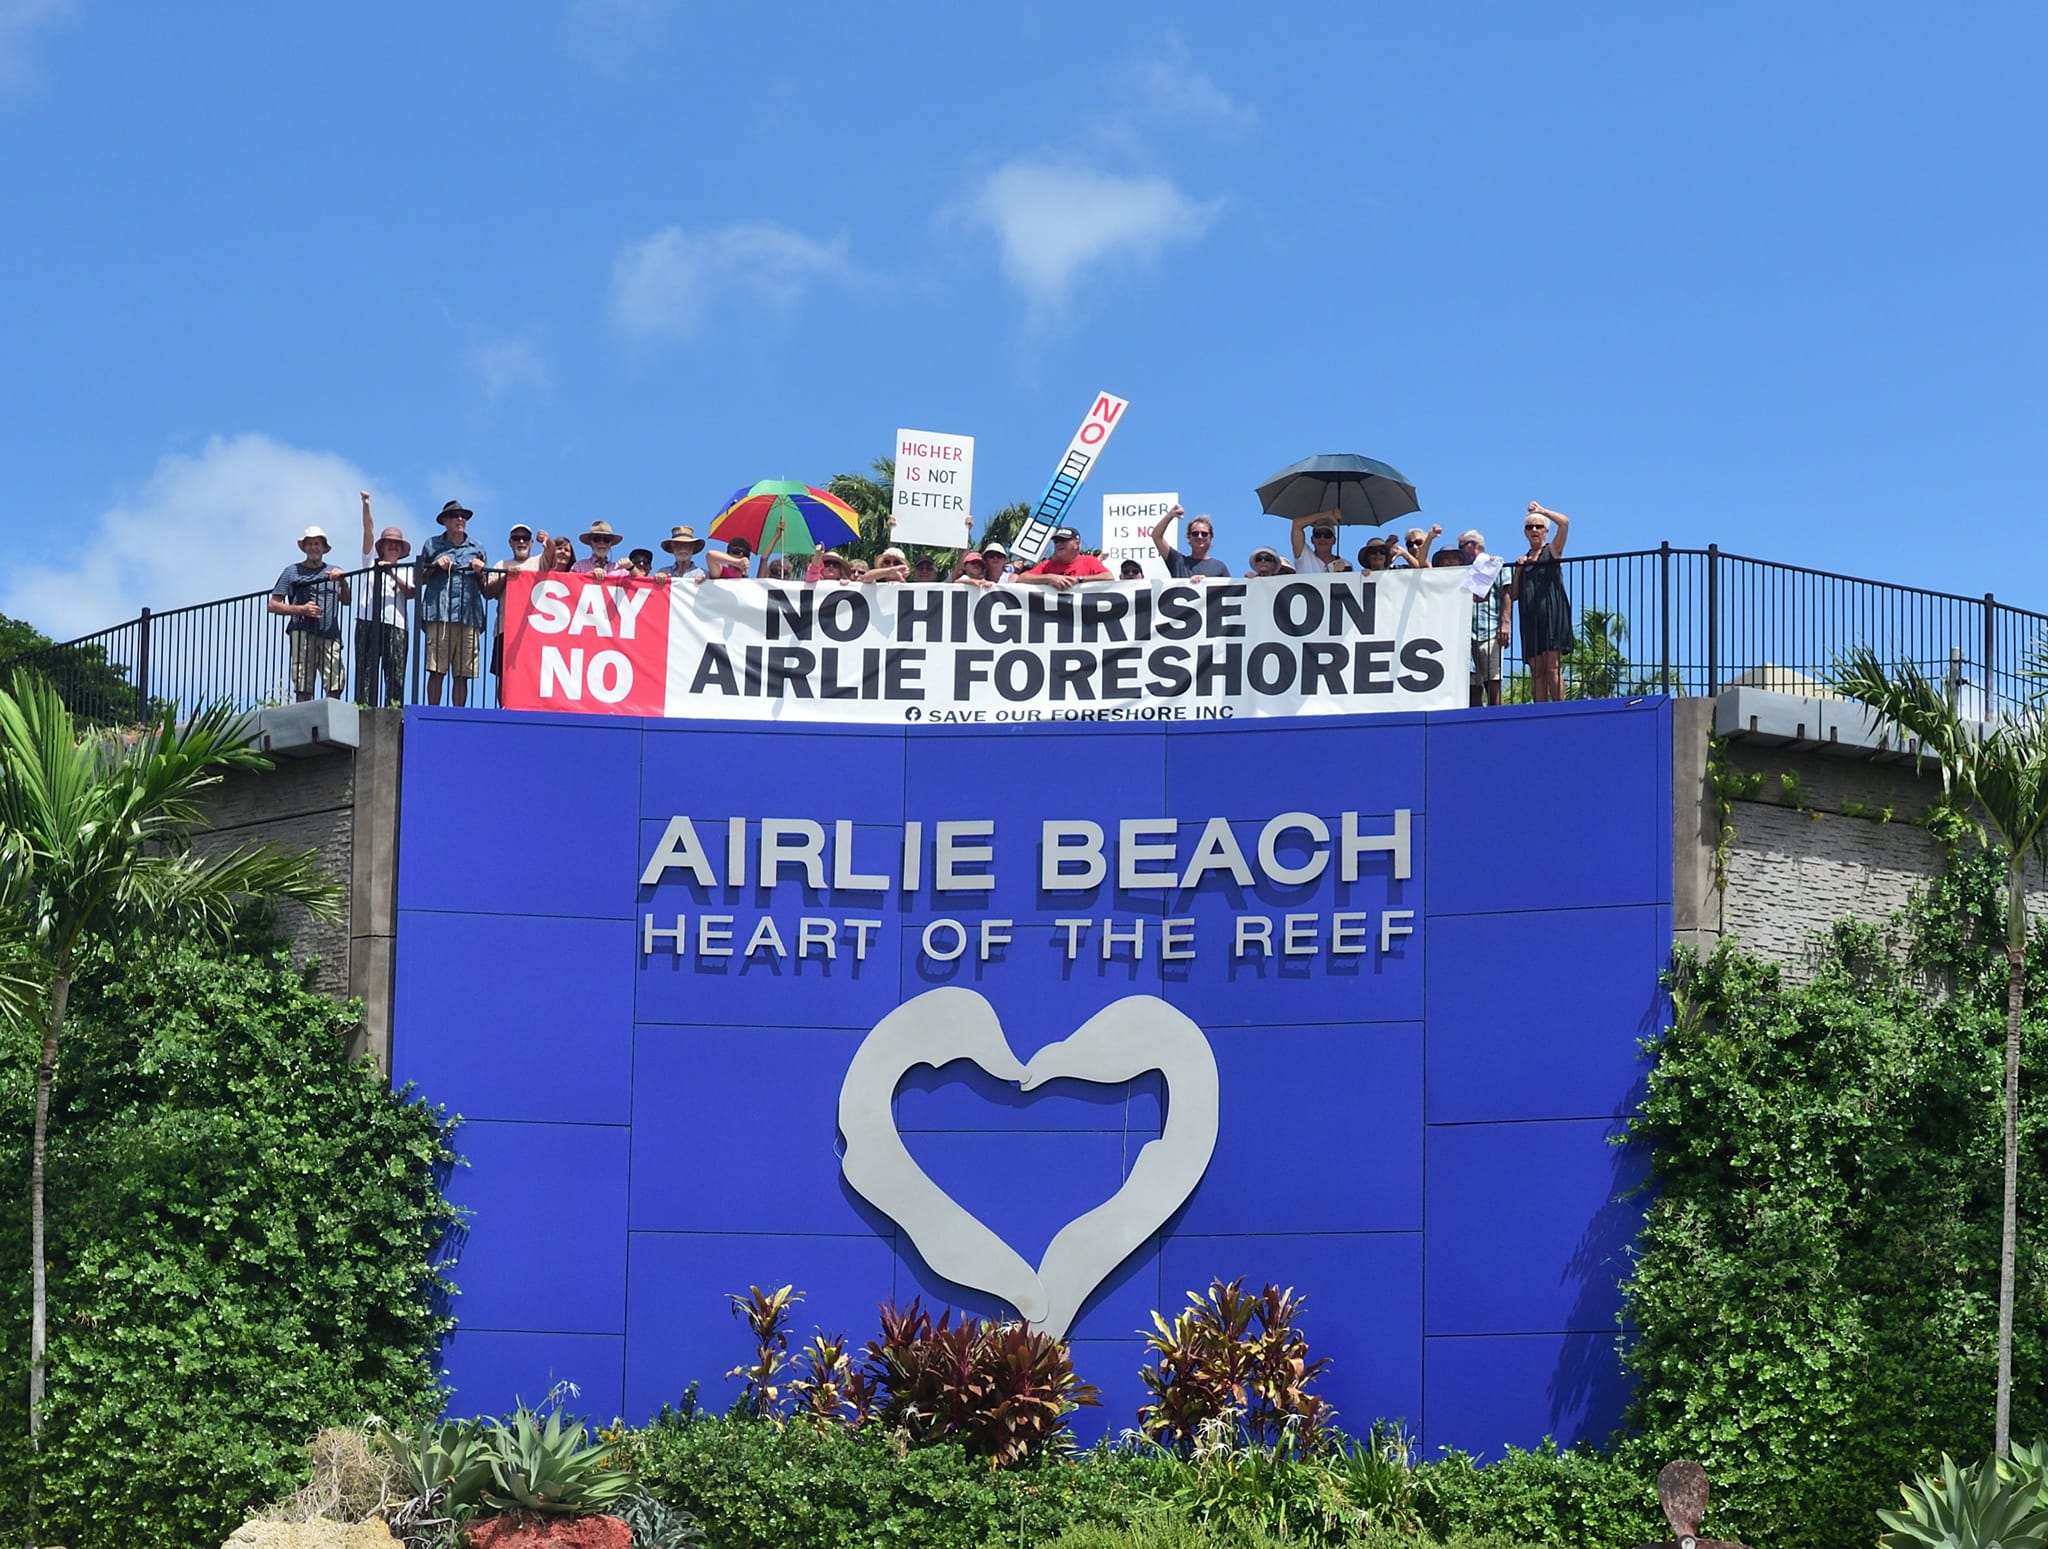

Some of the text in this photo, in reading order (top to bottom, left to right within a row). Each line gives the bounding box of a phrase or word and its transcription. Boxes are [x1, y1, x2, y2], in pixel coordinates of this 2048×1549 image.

[1080, 397, 1122, 444] NO
[902, 441, 963, 462] HIGHER
[906, 466, 957, 485] IS NOT
[898, 490, 964, 512] BETTER
[1109, 503, 1169, 517] HIGHER
[1114, 526, 1129, 538] IS
[1110, 547, 1161, 560] BETTE
[528, 581, 650, 640] SAY
[766, 582, 1376, 644] NO HIGHRISE ON
[540, 646, 633, 703] NO
[689, 637, 1445, 701] AIRLIE FORESHORES
[929, 705, 1234, 723] SAVE OUR FORESHORE INC
[639, 808, 1412, 891] AIRLIE BEACH
[643, 910, 1414, 961] HEART OF THE REEF
